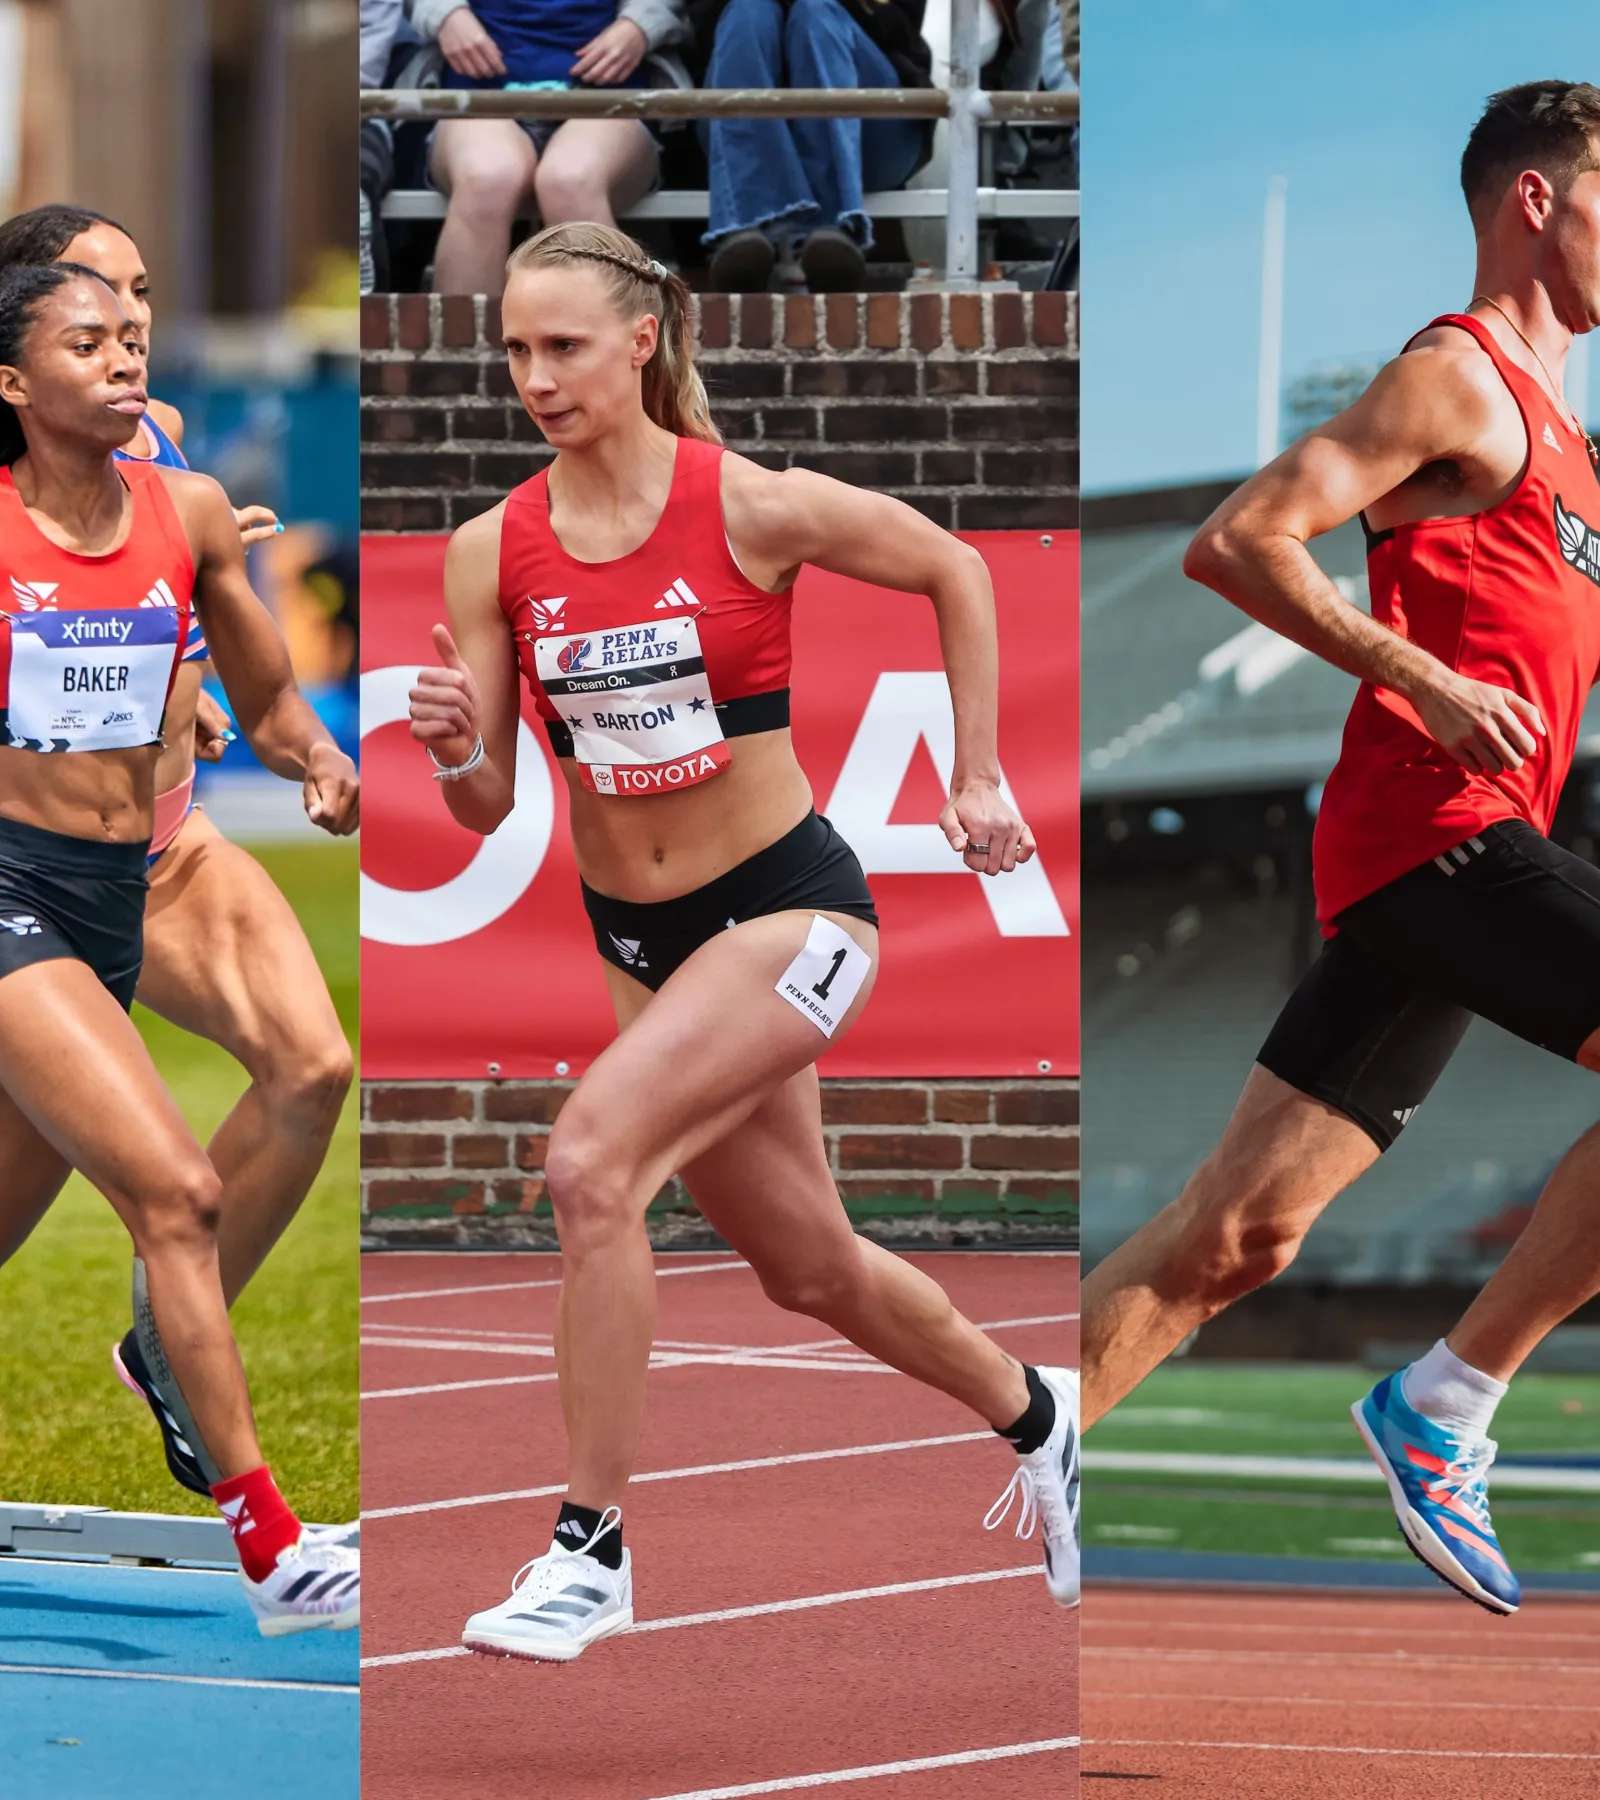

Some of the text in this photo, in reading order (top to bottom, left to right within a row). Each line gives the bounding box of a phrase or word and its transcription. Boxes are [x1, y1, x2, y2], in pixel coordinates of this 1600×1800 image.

[62, 616, 134, 644] xfinity
[601, 627, 657, 650] PENN
[601, 640, 678, 667] RELAYS
[63, 665, 130, 693] BAKER
[566, 674, 631, 692] Dream On.
[61, 716, 77, 724] NYC
[592, 703, 676, 731] BARTON
[617, 753, 718, 789] TOYOTA
[811, 947, 848, 1001] 1
[785, 982, 834, 1028] PENN RELAYS
